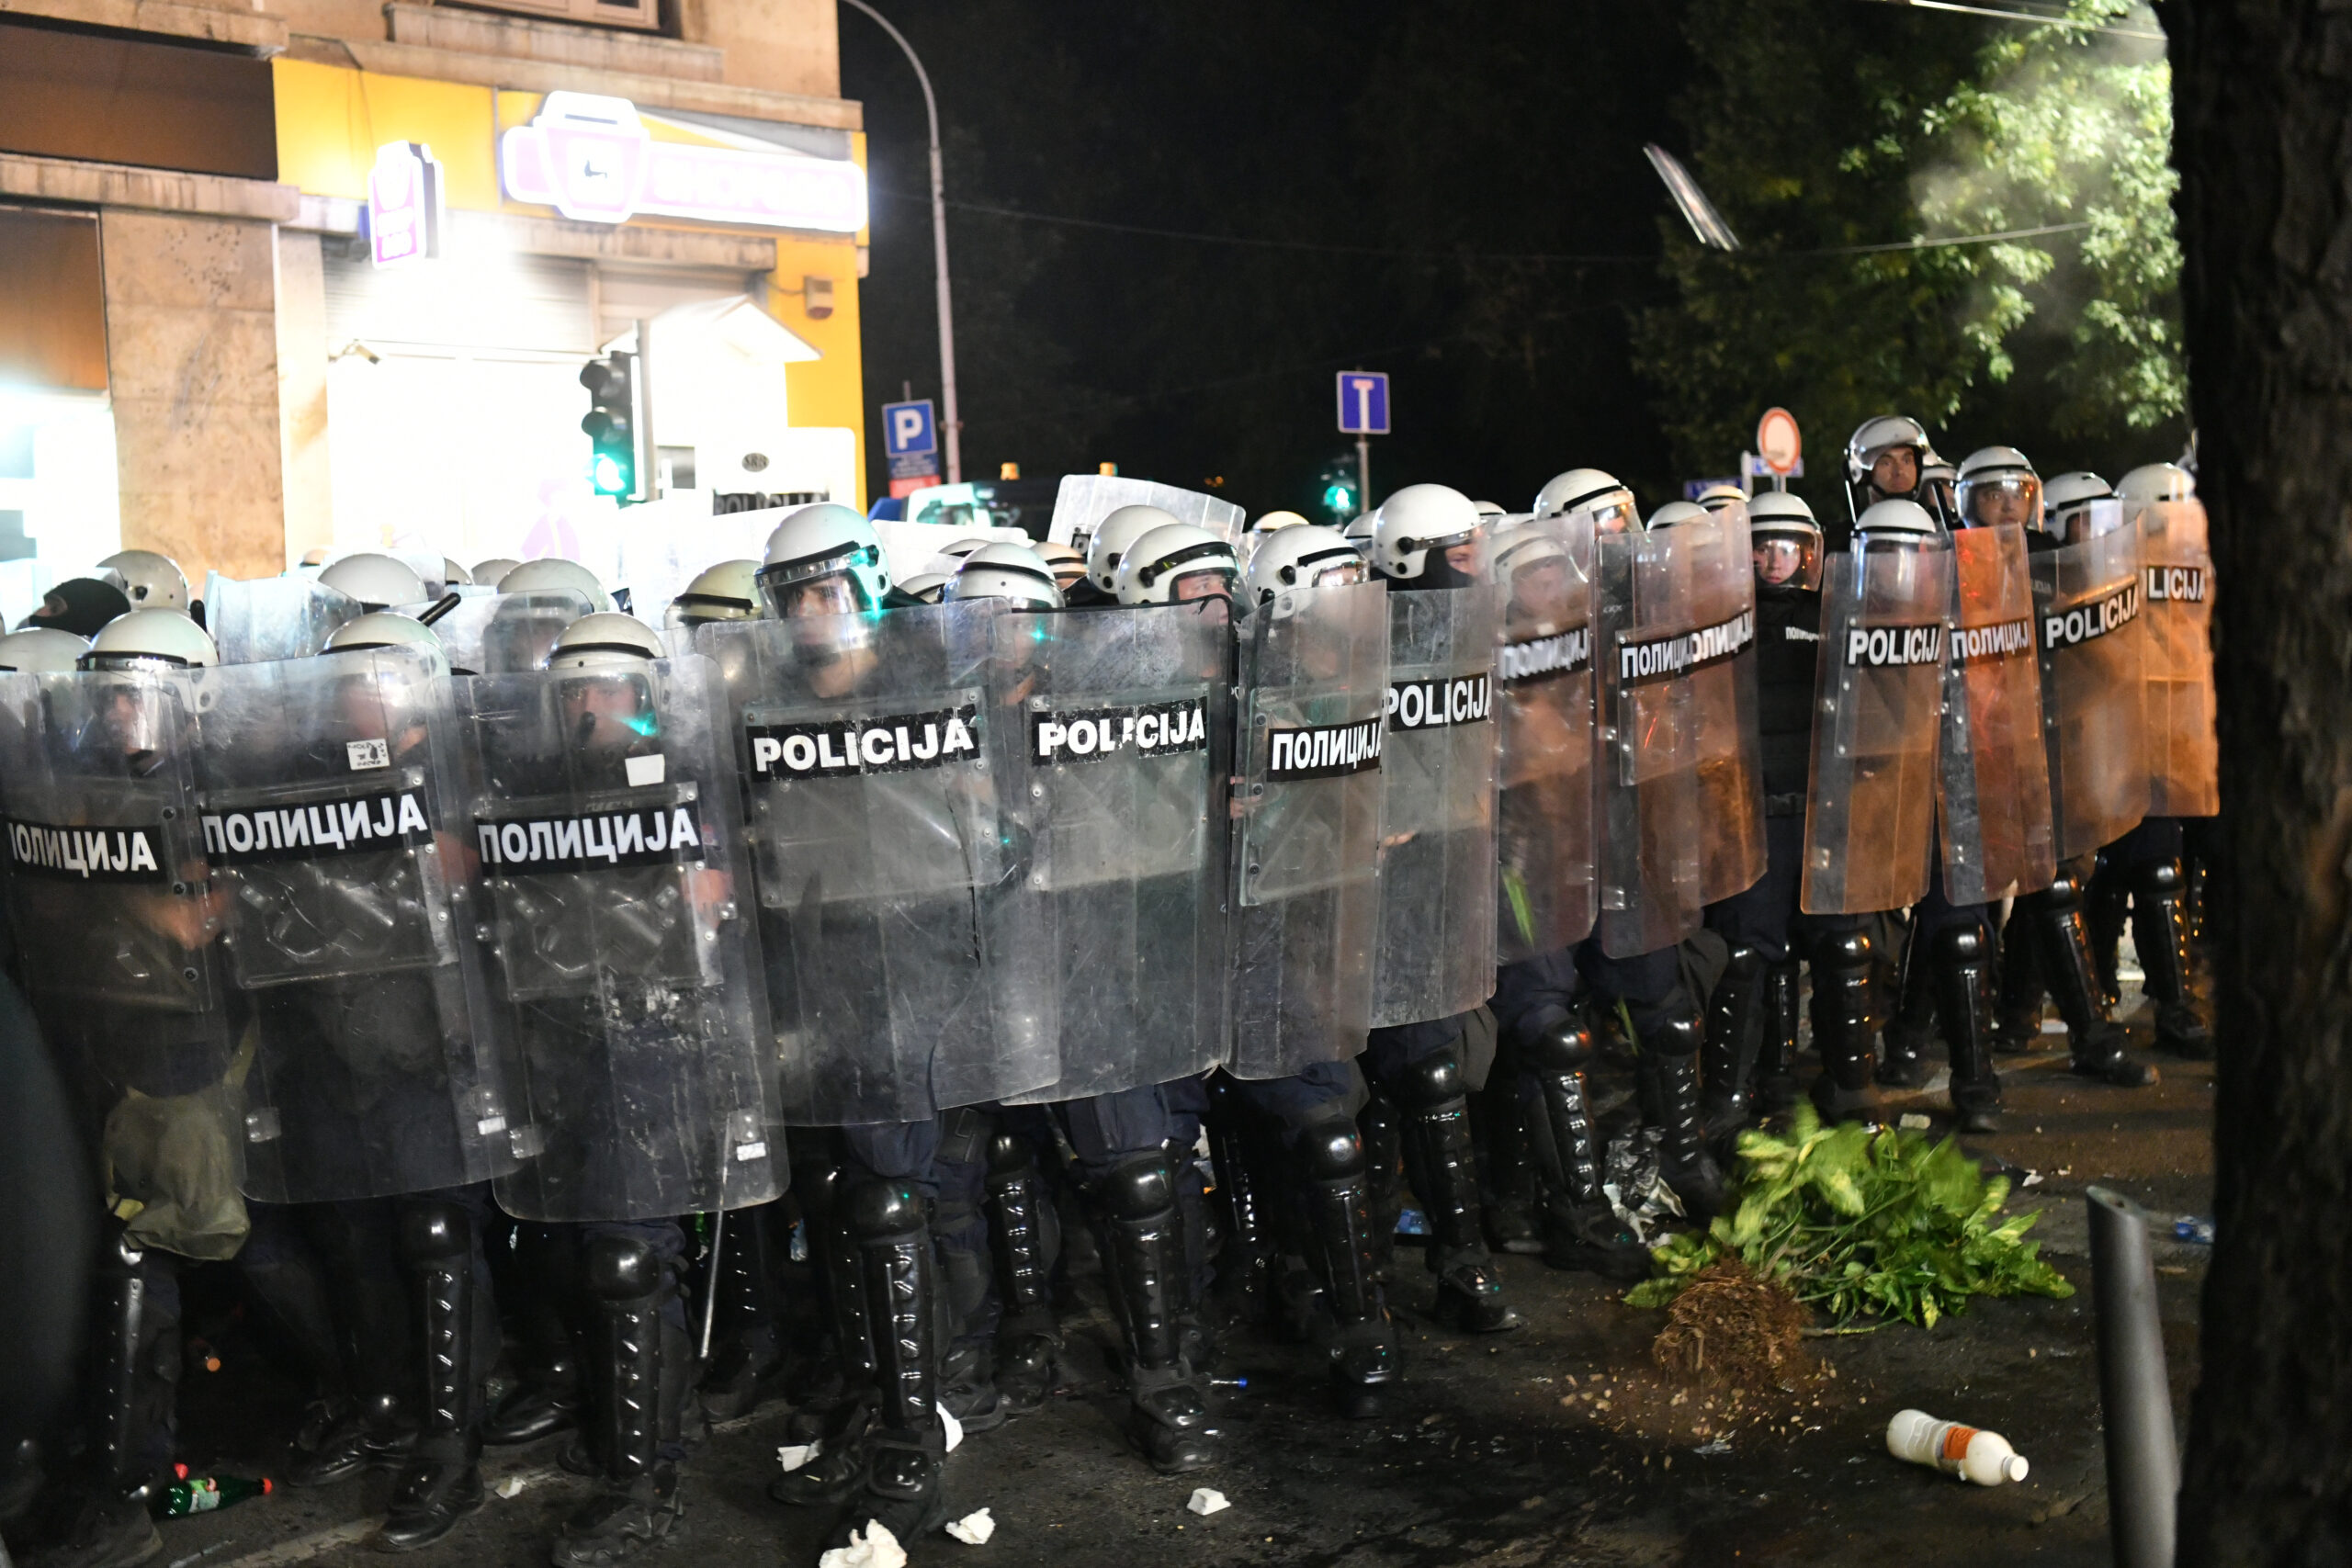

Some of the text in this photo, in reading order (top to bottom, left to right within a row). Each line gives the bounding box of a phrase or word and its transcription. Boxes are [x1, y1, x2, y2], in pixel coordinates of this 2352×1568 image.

[895, 409, 923, 450] P
[1951, 621, 2030, 660] ПОЛИЦИЈ
[753, 718, 973, 773] POLICIJA
[1038, 708, 1205, 756] POLICIJA
[202, 794, 427, 854] ПОЛИЦИЈА
[478, 807, 700, 863] ПОЛИЦИЈА
